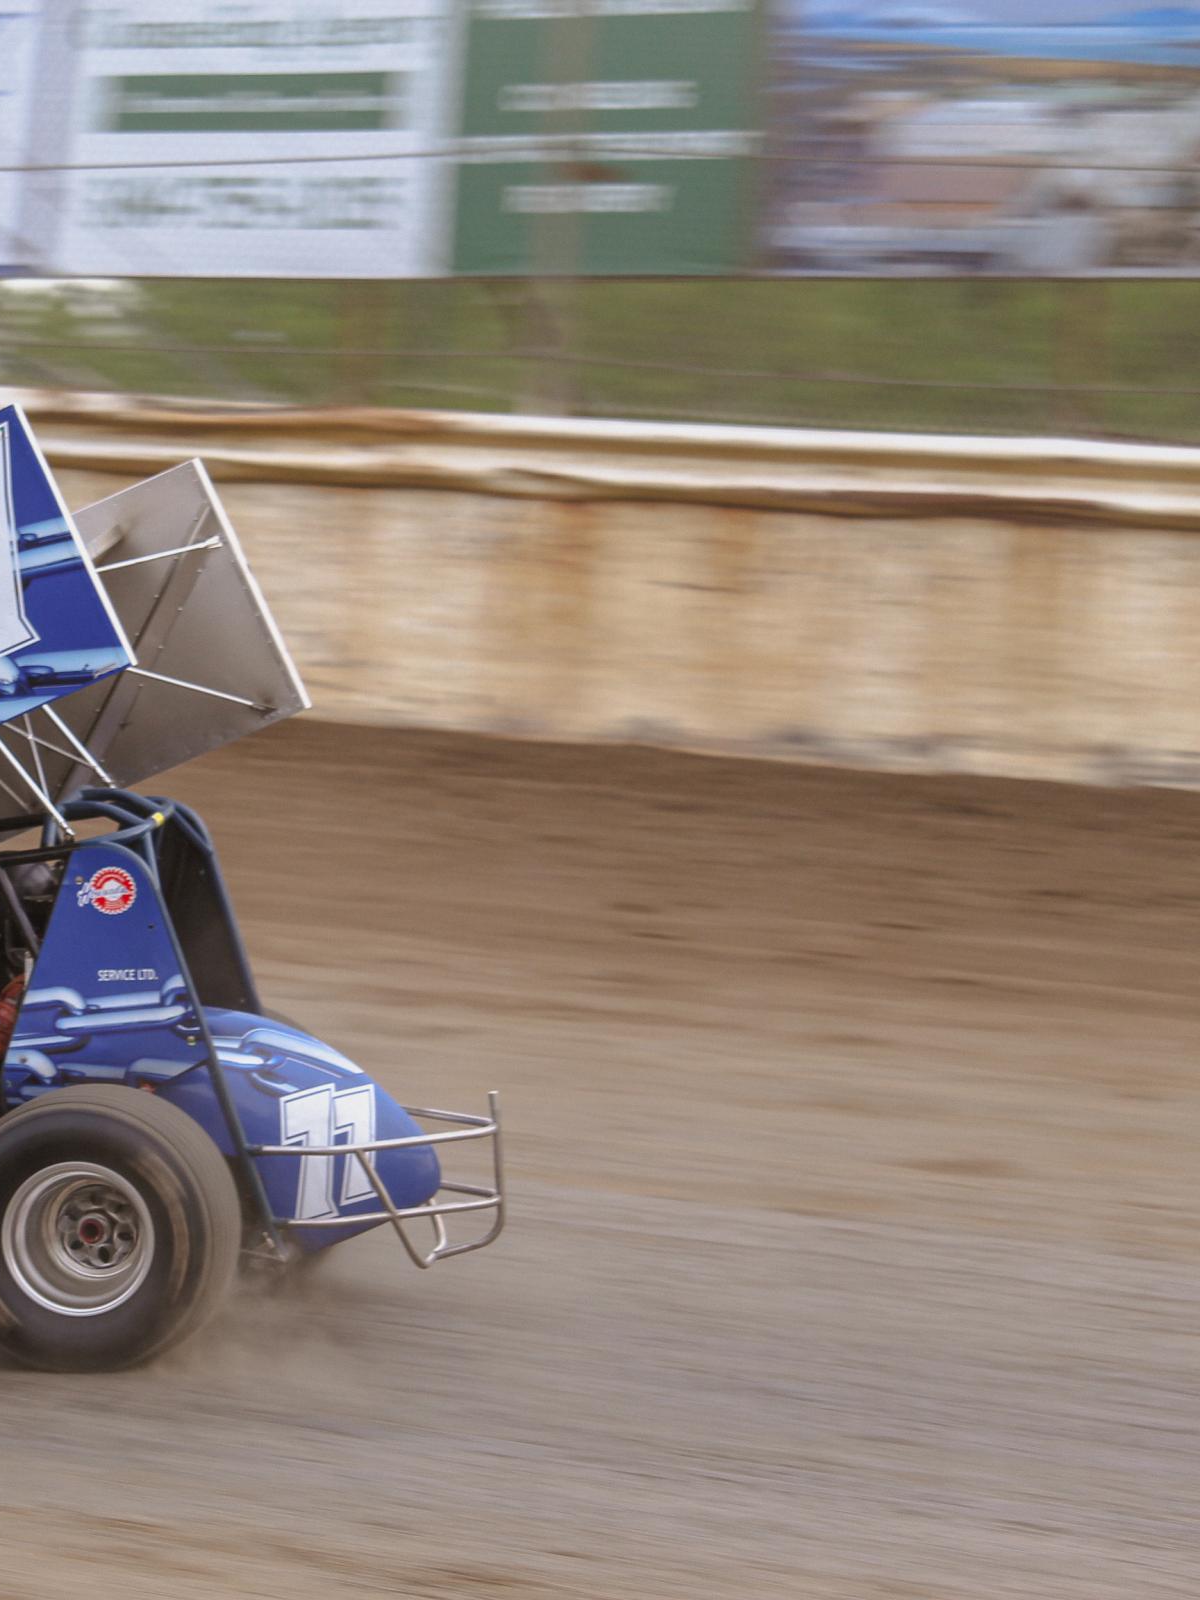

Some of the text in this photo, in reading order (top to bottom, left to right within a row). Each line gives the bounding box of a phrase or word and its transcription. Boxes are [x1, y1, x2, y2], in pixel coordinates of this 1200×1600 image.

[97, 968, 159, 982] SERVICE LTD.
[279, 1083, 379, 1220] 77
